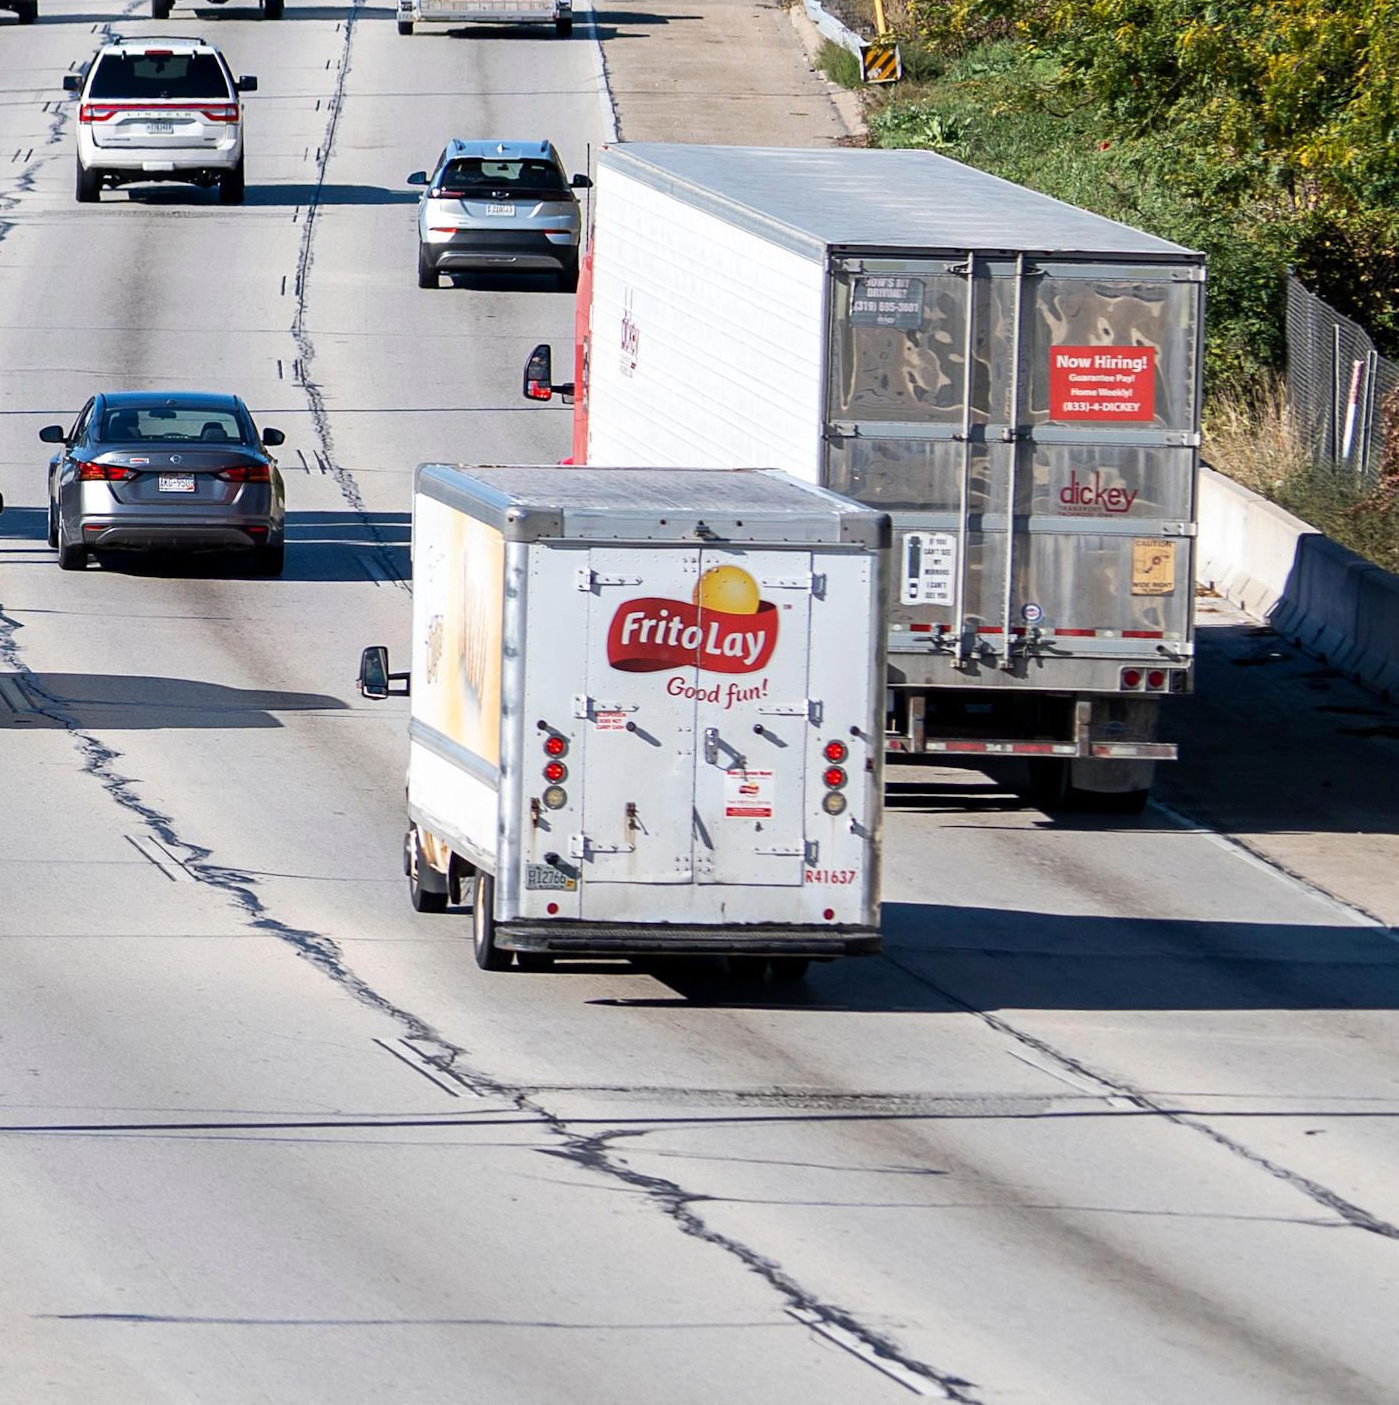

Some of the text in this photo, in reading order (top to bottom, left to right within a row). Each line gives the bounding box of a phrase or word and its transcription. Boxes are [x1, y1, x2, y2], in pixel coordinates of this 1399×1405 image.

[1056, 355, 1148, 373] Now Hiring!
[1068, 374, 1136, 383] Guarantee Pay!
[1070, 388, 1134, 398] Home Weekly!
[1063, 402, 1141, 412] (833)-4-DICKEY
[1059, 470, 1139, 513] dickey
[1135, 540, 1172, 548] CAUTION
[667, 676, 769, 710] Good fun!
[805, 869, 856, 884] R41637
